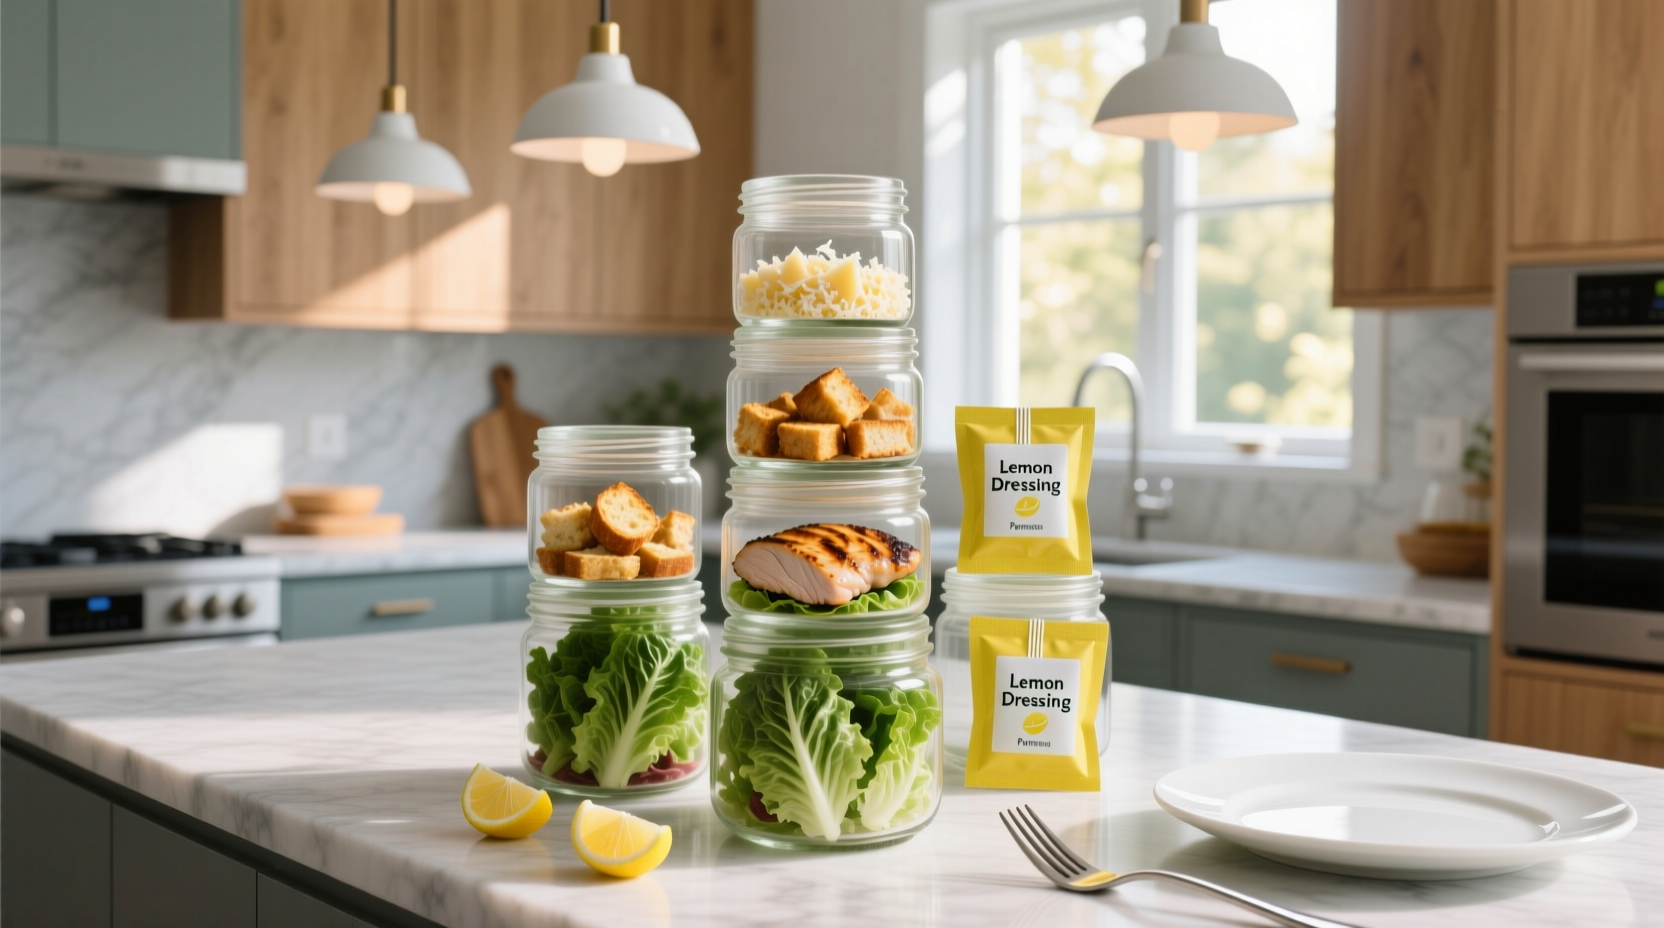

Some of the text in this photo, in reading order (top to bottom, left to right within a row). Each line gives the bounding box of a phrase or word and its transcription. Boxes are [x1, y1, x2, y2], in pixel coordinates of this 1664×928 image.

[1000, 460, 1052, 474] Lemon
[991, 477, 1061, 496] Dressing
[1010, 673, 1064, 690] Lemon
[1002, 691, 1071, 713] Dressing
